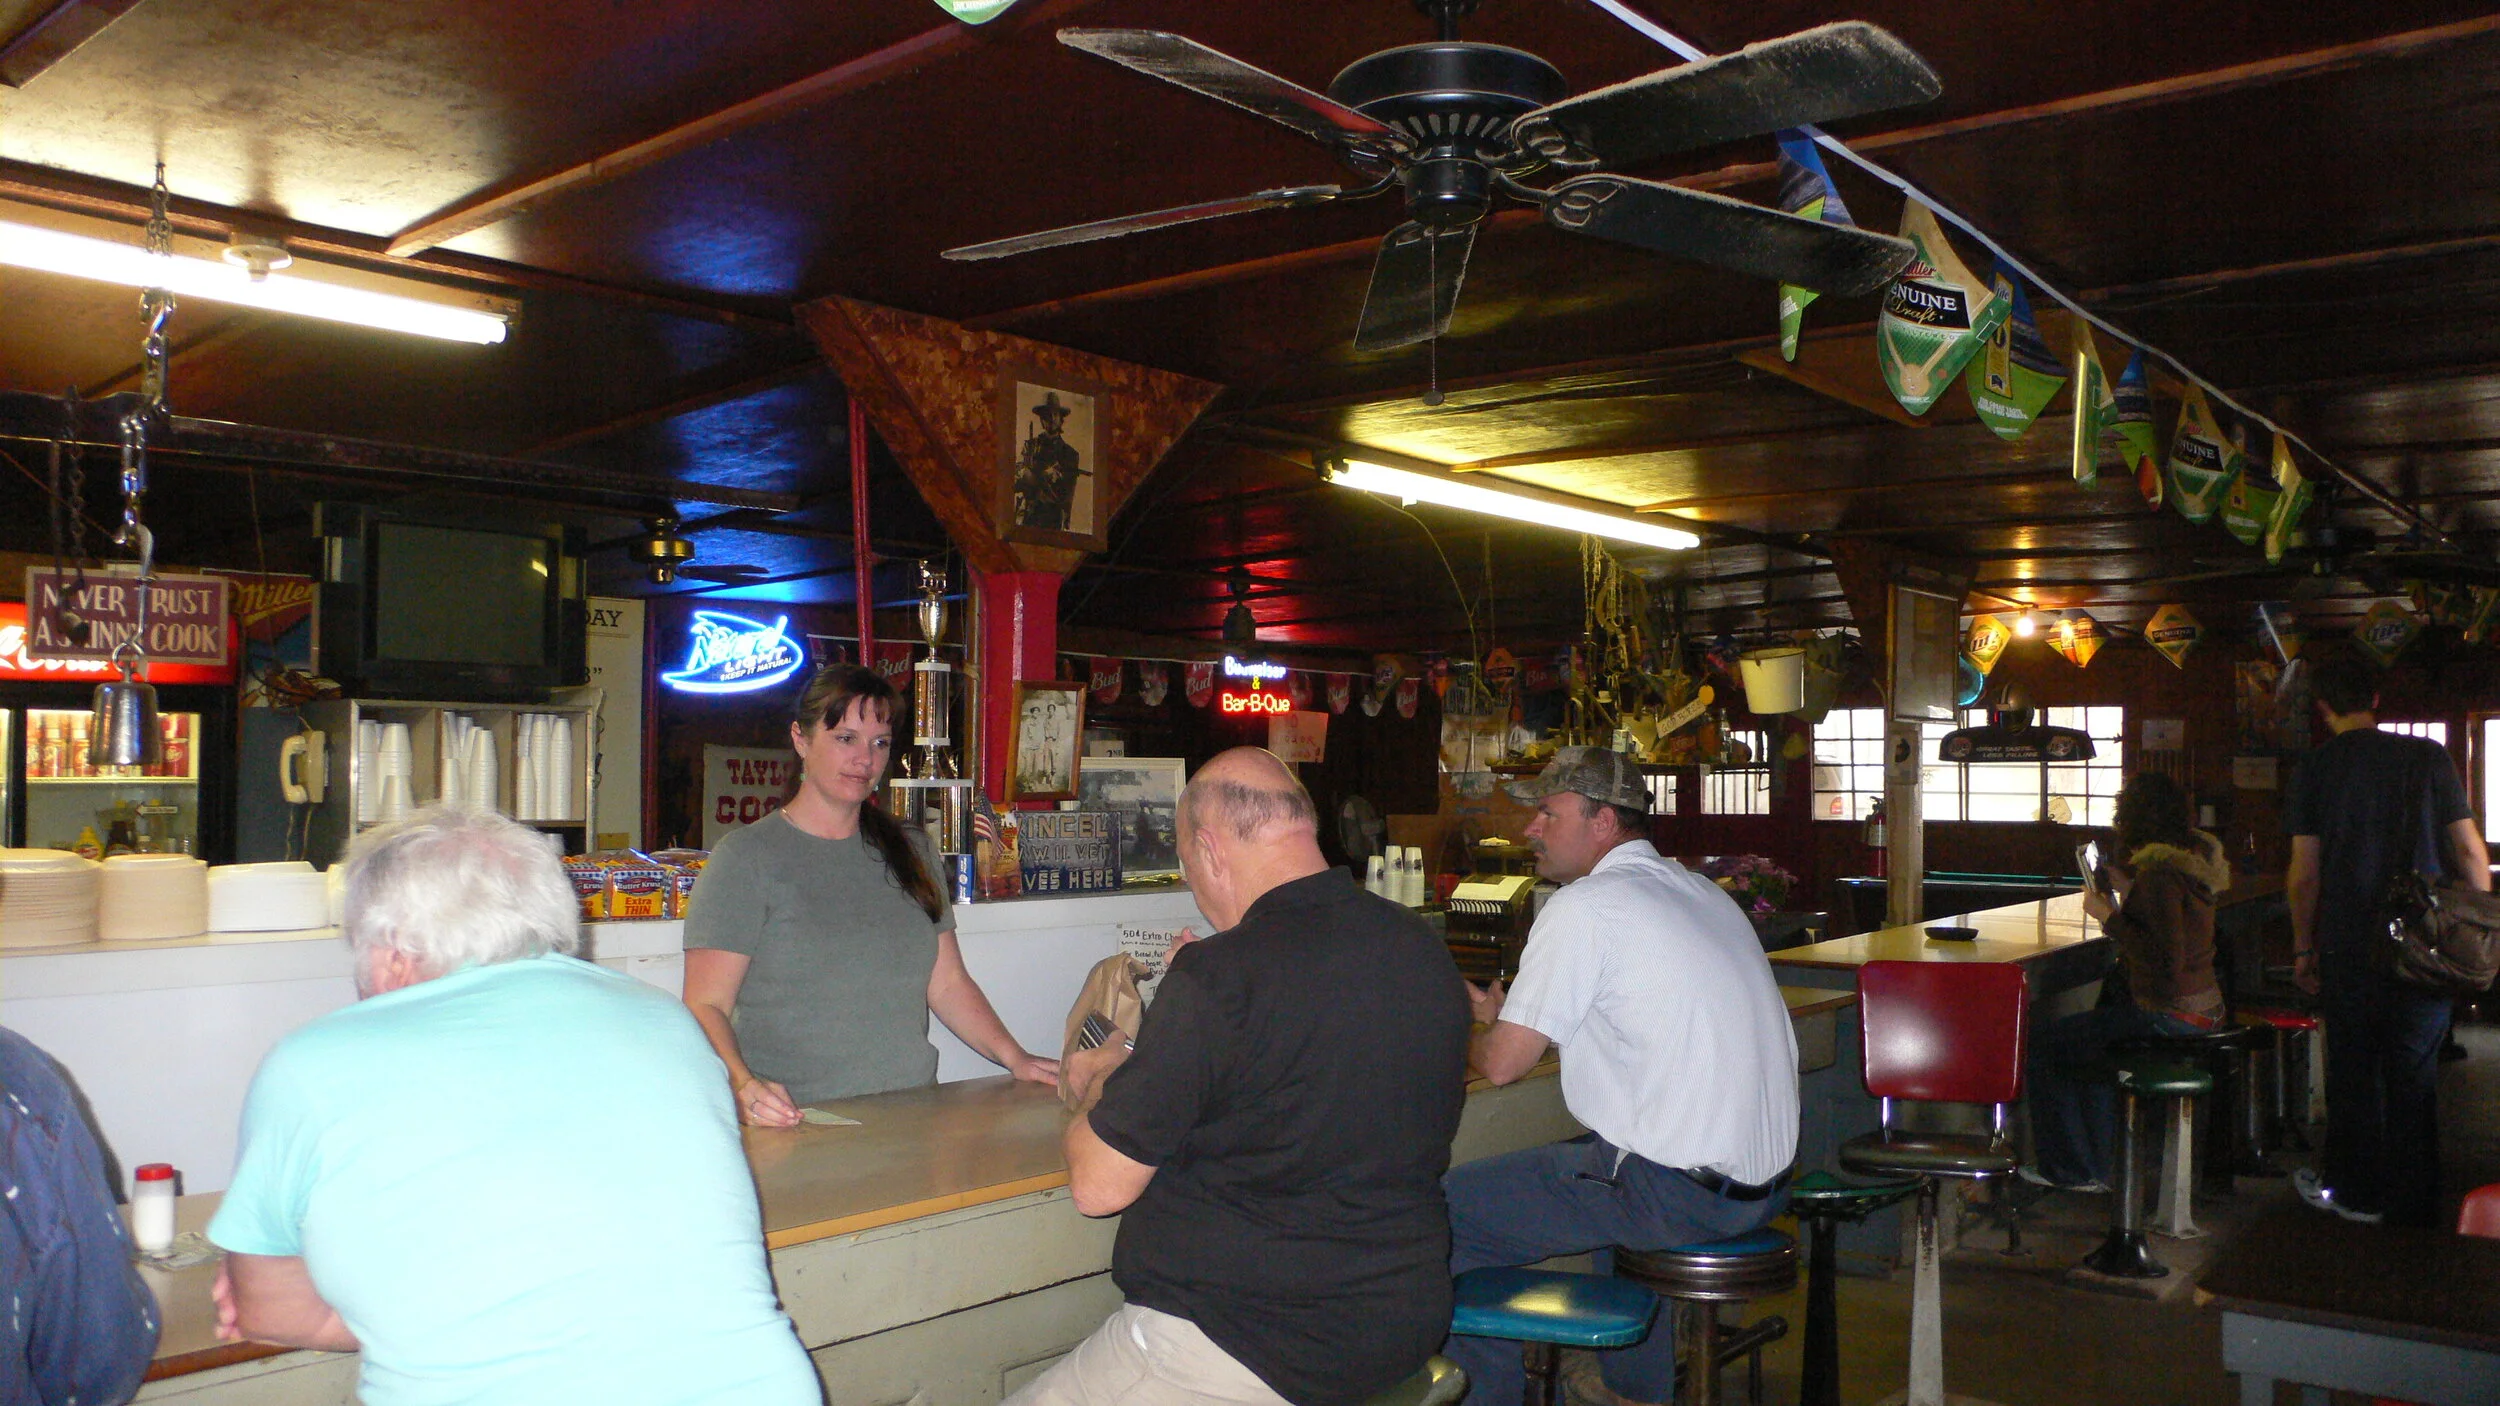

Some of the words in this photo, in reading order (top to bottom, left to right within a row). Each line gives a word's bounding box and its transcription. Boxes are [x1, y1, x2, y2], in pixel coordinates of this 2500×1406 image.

[1904, 260, 1937, 276] iller
[43, 583, 127, 617] NVER
[34, 616, 53, 646] A
[150, 623, 218, 653] COOK
[747, 666, 756, 676] IT
[757, 657, 793, 673] NATURAL
[875, 651, 913, 679] Bud
[1090, 666, 1122, 691] Bud
[1186, 671, 1213, 696] Bud
[1251, 675, 1261, 690] &
[1222, 692, 1291, 713] Bar-B-Que
[1075, 843, 1111, 863] VET
[1025, 869, 1060, 891] VES
[1069, 868, 1114, 889] HERE
[625, 896, 653, 905] Extra
[625, 905, 651, 915] THIN
